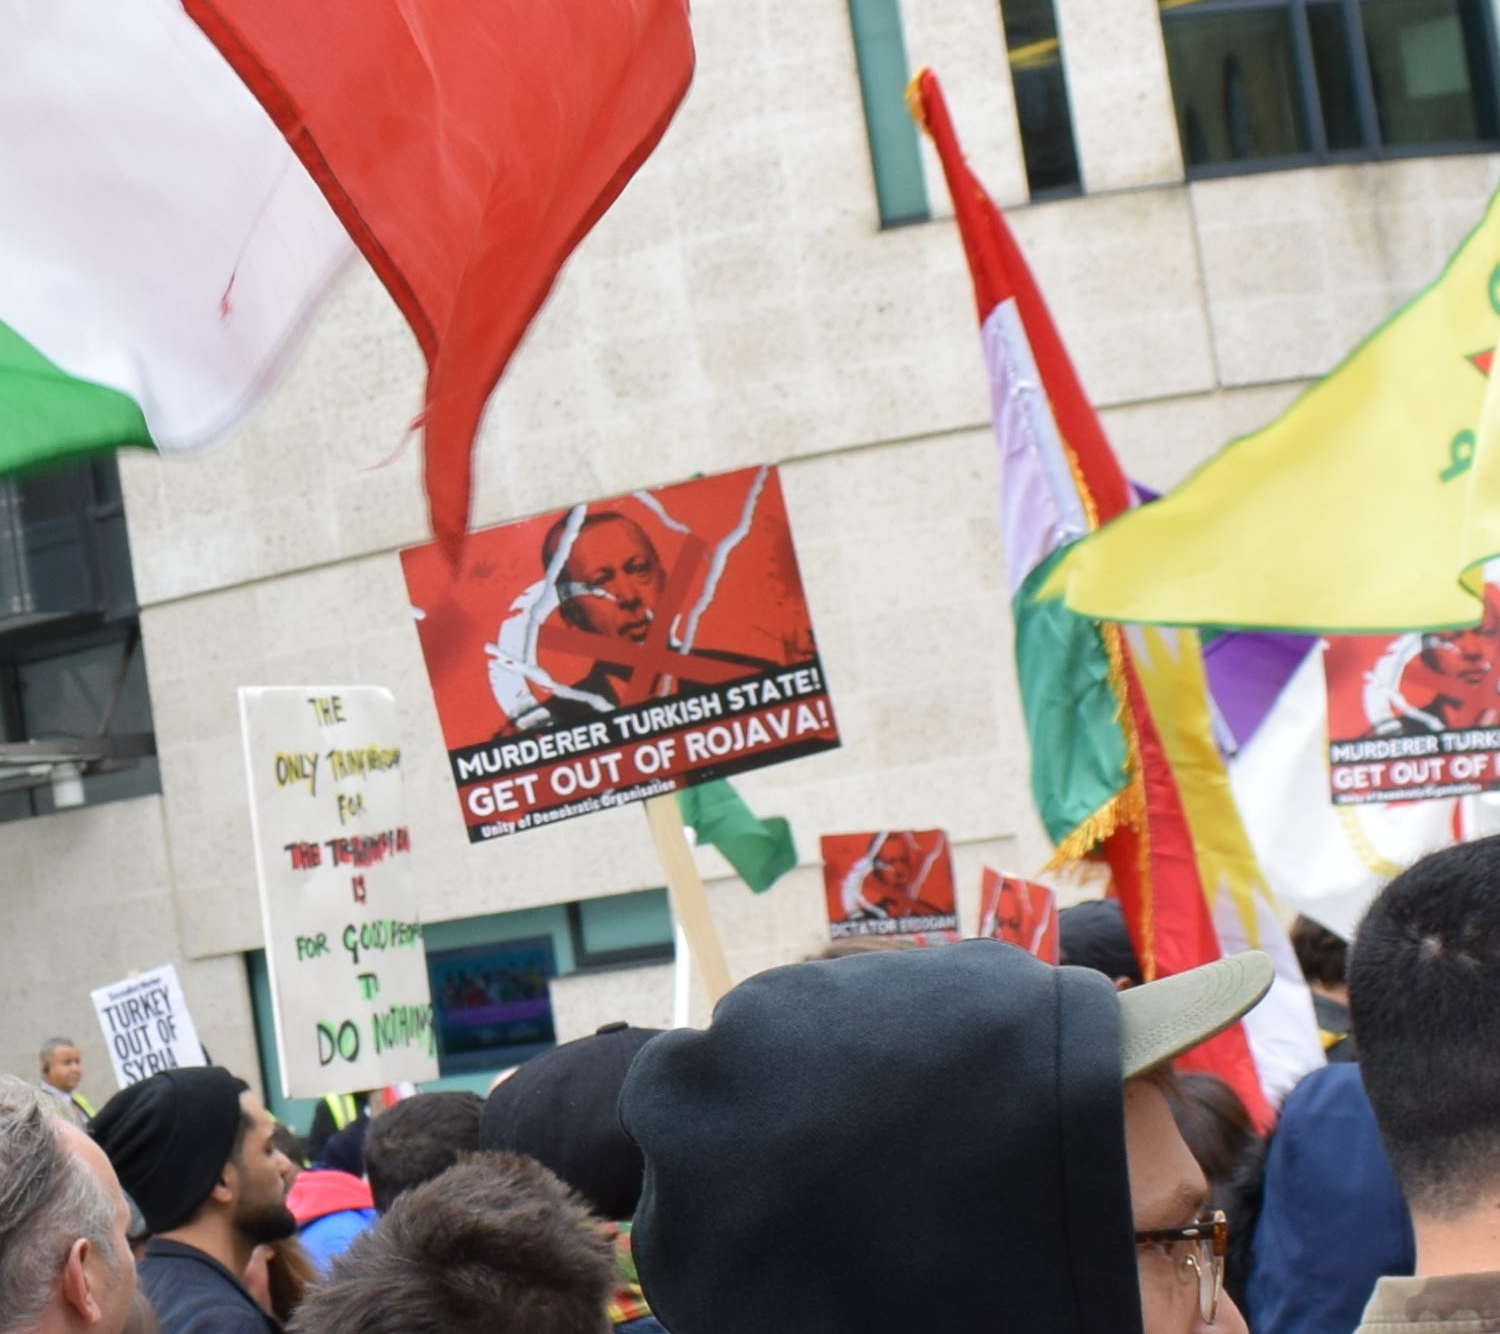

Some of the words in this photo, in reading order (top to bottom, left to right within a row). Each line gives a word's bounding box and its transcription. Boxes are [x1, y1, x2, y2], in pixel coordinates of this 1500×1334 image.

[307, 695, 347, 727] THE
[456, 723, 610, 781] MURDERER
[613, 691, 723, 740] TURKISH
[728, 666, 823, 712] STATE!
[275, 749, 319, 797] ONLY
[466, 774, 540, 818] GET
[550, 751, 623, 797] OUT
[633, 738, 677, 775] OF
[686, 700, 831, 764] ROJAVA!
[1330, 735, 1439, 764] MURDERER
[1332, 763, 1386, 791] GET
[1390, 757, 1445, 786] OUT
[1450, 753, 1488, 780] OF
[480, 819, 517, 838] Unity
[518, 813, 533, 829] of
[533, 795, 600, 826] Demokratic
[600, 778, 677, 807] Organisation
[284, 840, 322, 871] THE
[296, 931, 330, 961] FOR
[830, 917, 897, 936] DICTATOR
[102, 984, 173, 1033] TURKEY
[113, 1024, 152, 1061] OUT
[156, 1014, 178, 1044] OF
[316, 1018, 360, 1067] DO
